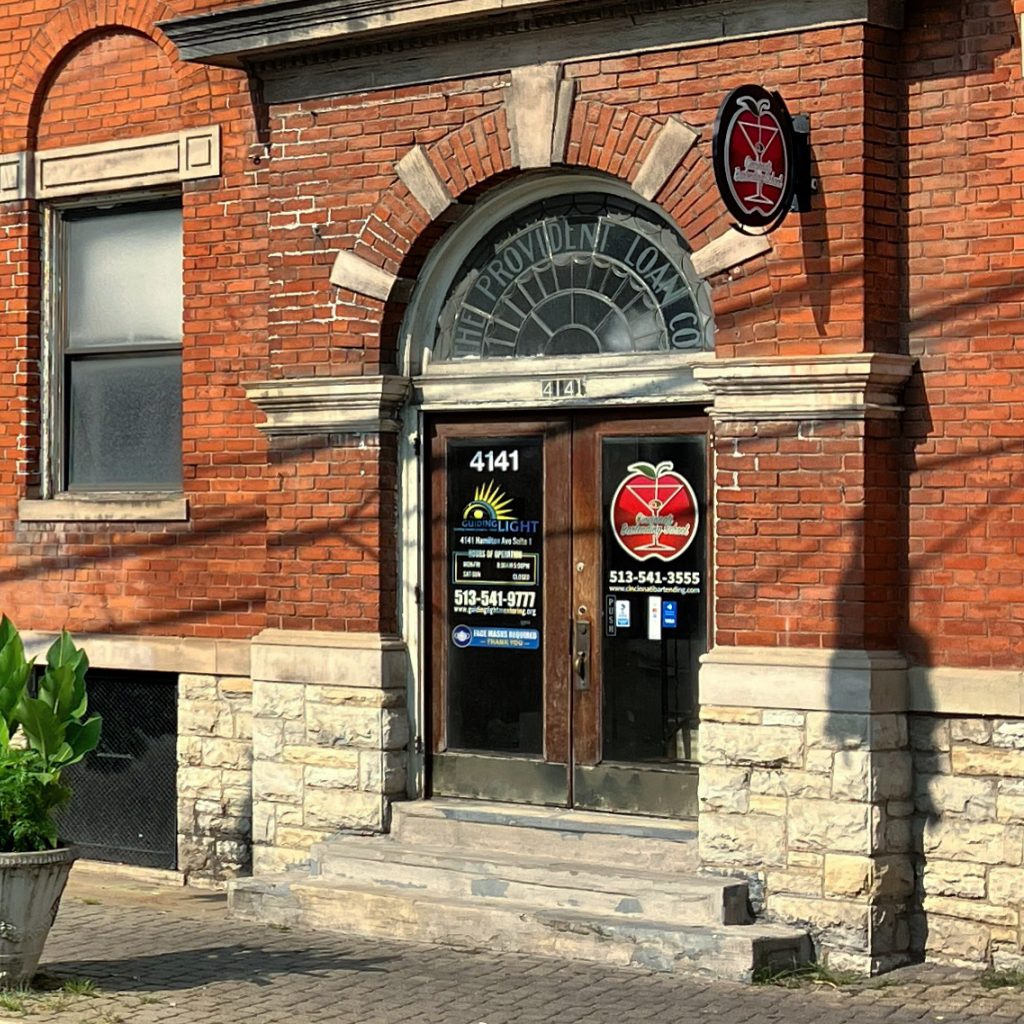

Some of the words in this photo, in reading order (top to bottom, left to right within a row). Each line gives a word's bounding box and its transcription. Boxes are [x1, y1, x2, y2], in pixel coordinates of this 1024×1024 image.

[475, 222, 611, 303] PROVIDENT
[624, 233, 689, 306] LOAN
[543, 378, 583, 398] 4141
[469, 449, 519, 472] 4141
[497, 520, 539, 533] LIGHT
[459, 536, 474, 545] 4141
[609, 571, 700, 585] 513-541-3555
[454, 589, 536, 608] 513-541-9777
